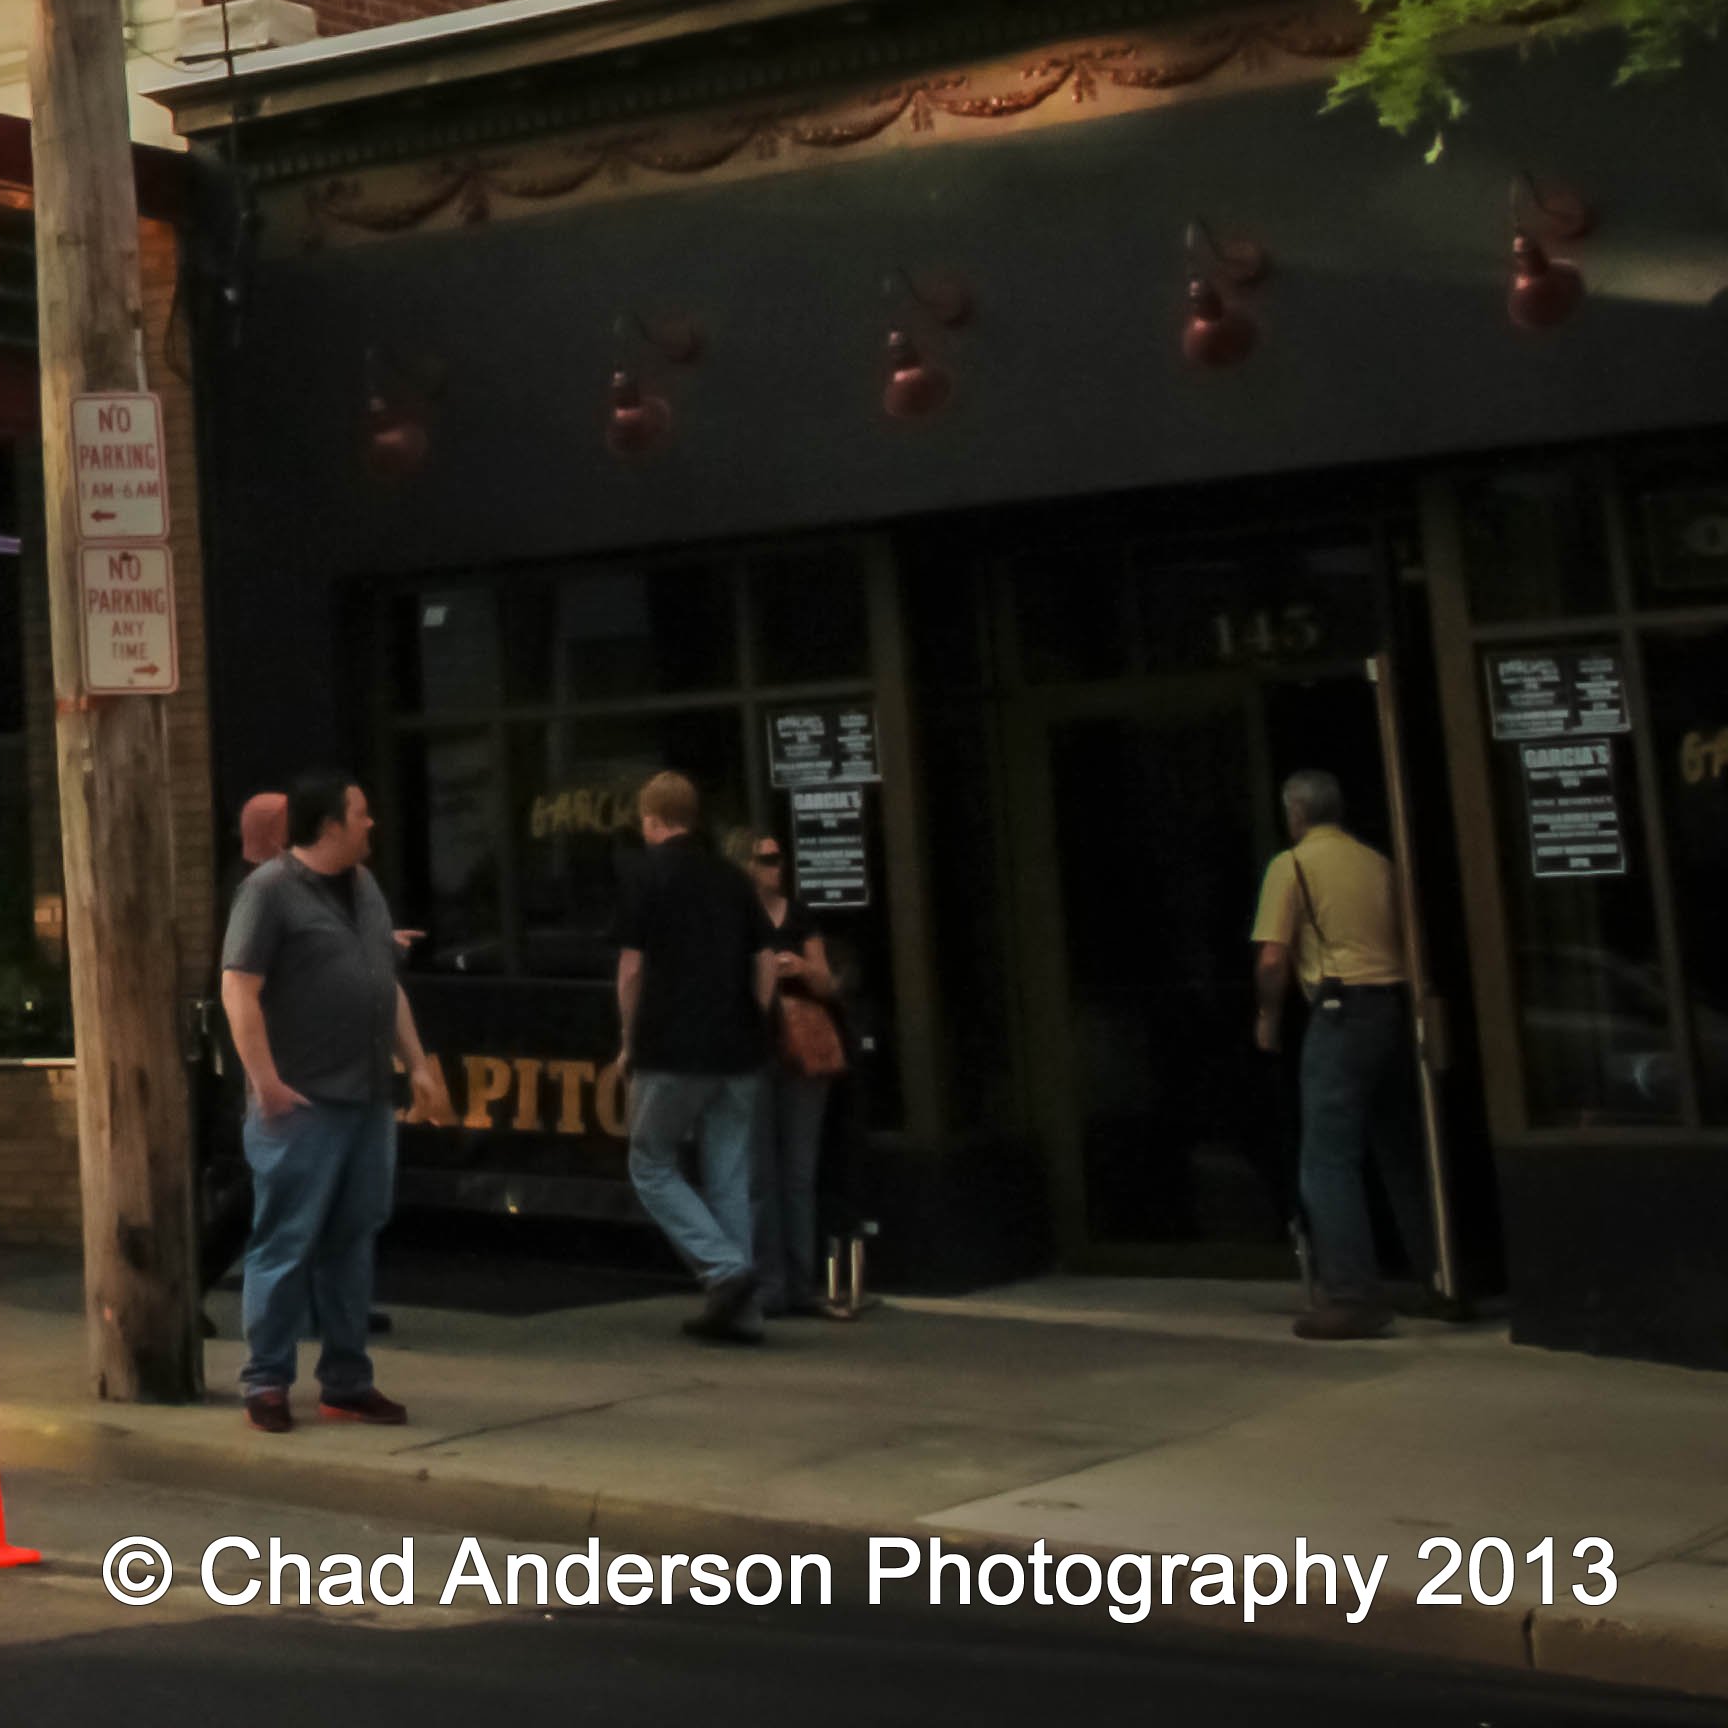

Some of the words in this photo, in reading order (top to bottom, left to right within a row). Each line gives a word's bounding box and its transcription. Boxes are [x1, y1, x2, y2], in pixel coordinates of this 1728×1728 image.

[98, 406, 132, 433] NO
[79, 443, 156, 470] PARKING
[108, 554, 142, 582] NO
[87, 588, 166, 615] PARKING
[111, 620, 145, 637] ANY
[111, 641, 149, 661] TIME
